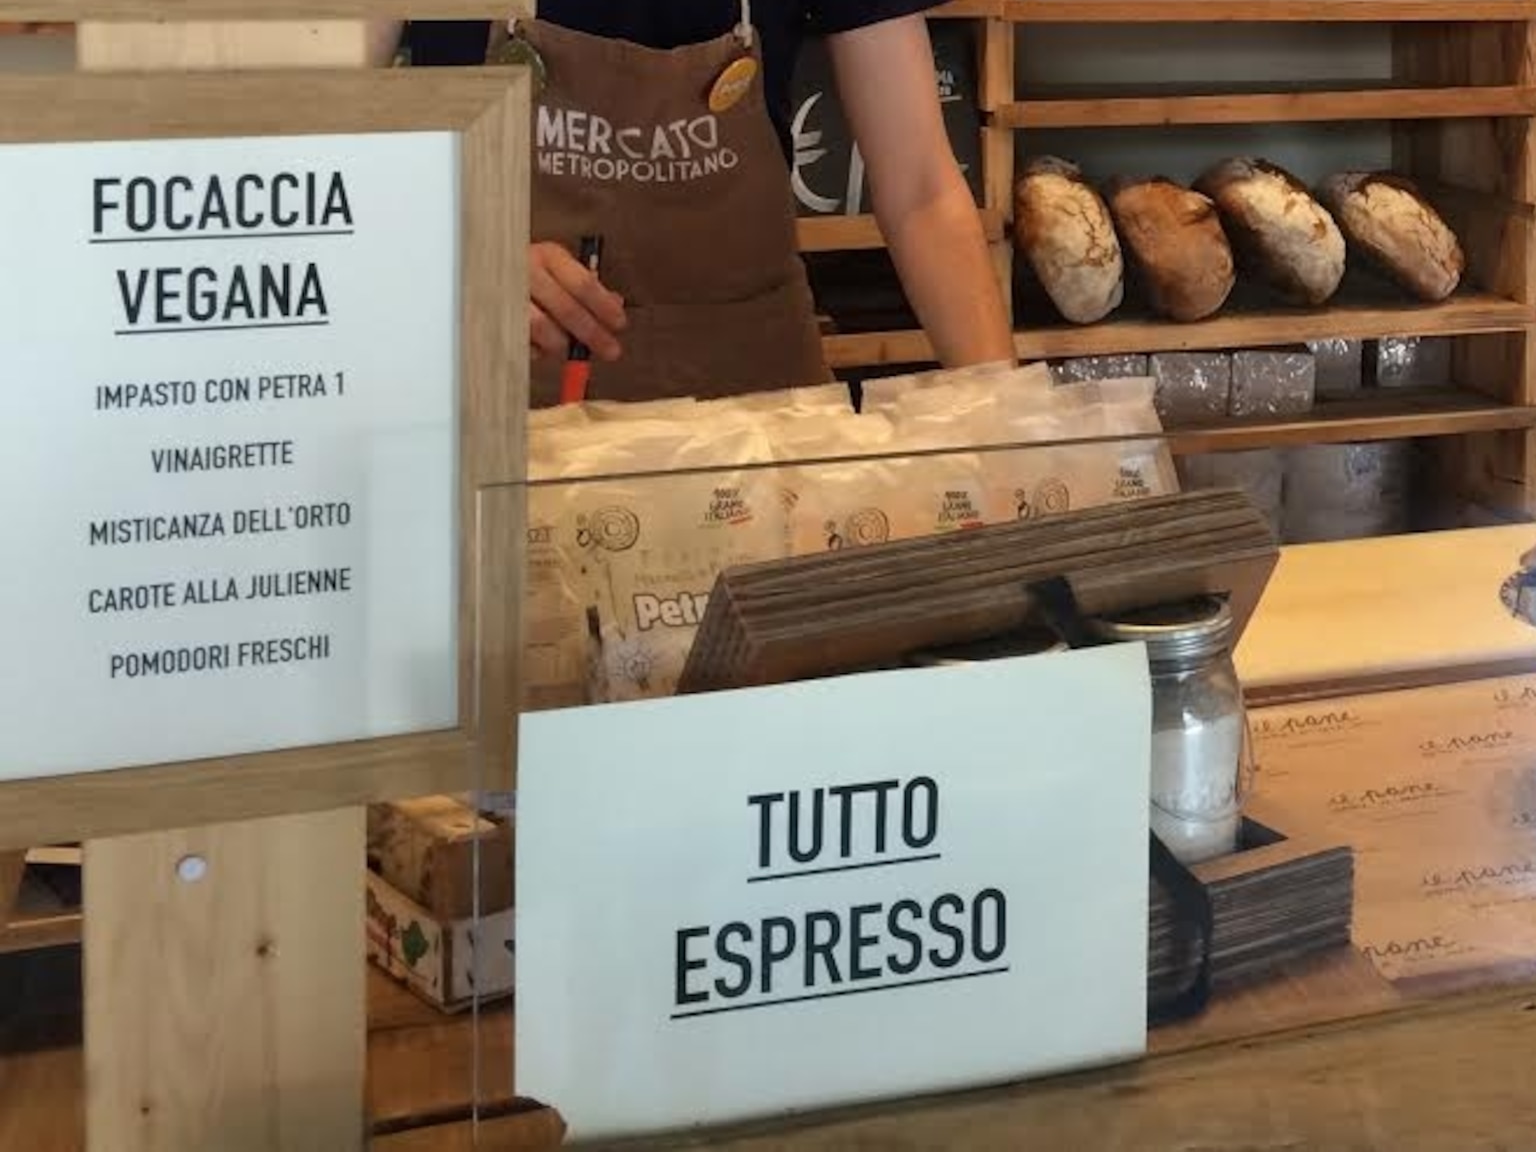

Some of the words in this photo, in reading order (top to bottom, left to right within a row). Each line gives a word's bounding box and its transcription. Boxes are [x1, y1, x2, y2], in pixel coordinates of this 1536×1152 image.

[535, 104, 718, 160] MERCATO
[537, 148, 739, 183] METROPOLITANO
[94, 171, 353, 234] FOCACCIA
[117, 262, 328, 324] VEGANA
[97, 381, 196, 410] IMPASTO
[205, 378, 249, 403] CON
[259, 374, 326, 400] PETRA
[335, 372, 343, 395] 1
[152, 441, 293, 473] VINAIGRETTE
[90, 513, 225, 546] MISTICANZA
[233, 502, 351, 534] DELL'ORTO
[89, 583, 175, 613] CAROTE
[183, 578, 239, 604] ALLA
[246, 568, 351, 599] JULIENNE
[111, 645, 229, 678] POMODORI
[238, 635, 329, 666] FRESCHI
[748, 776, 939, 868] TUTTO
[675, 888, 1007, 1005] ESPRESSO
